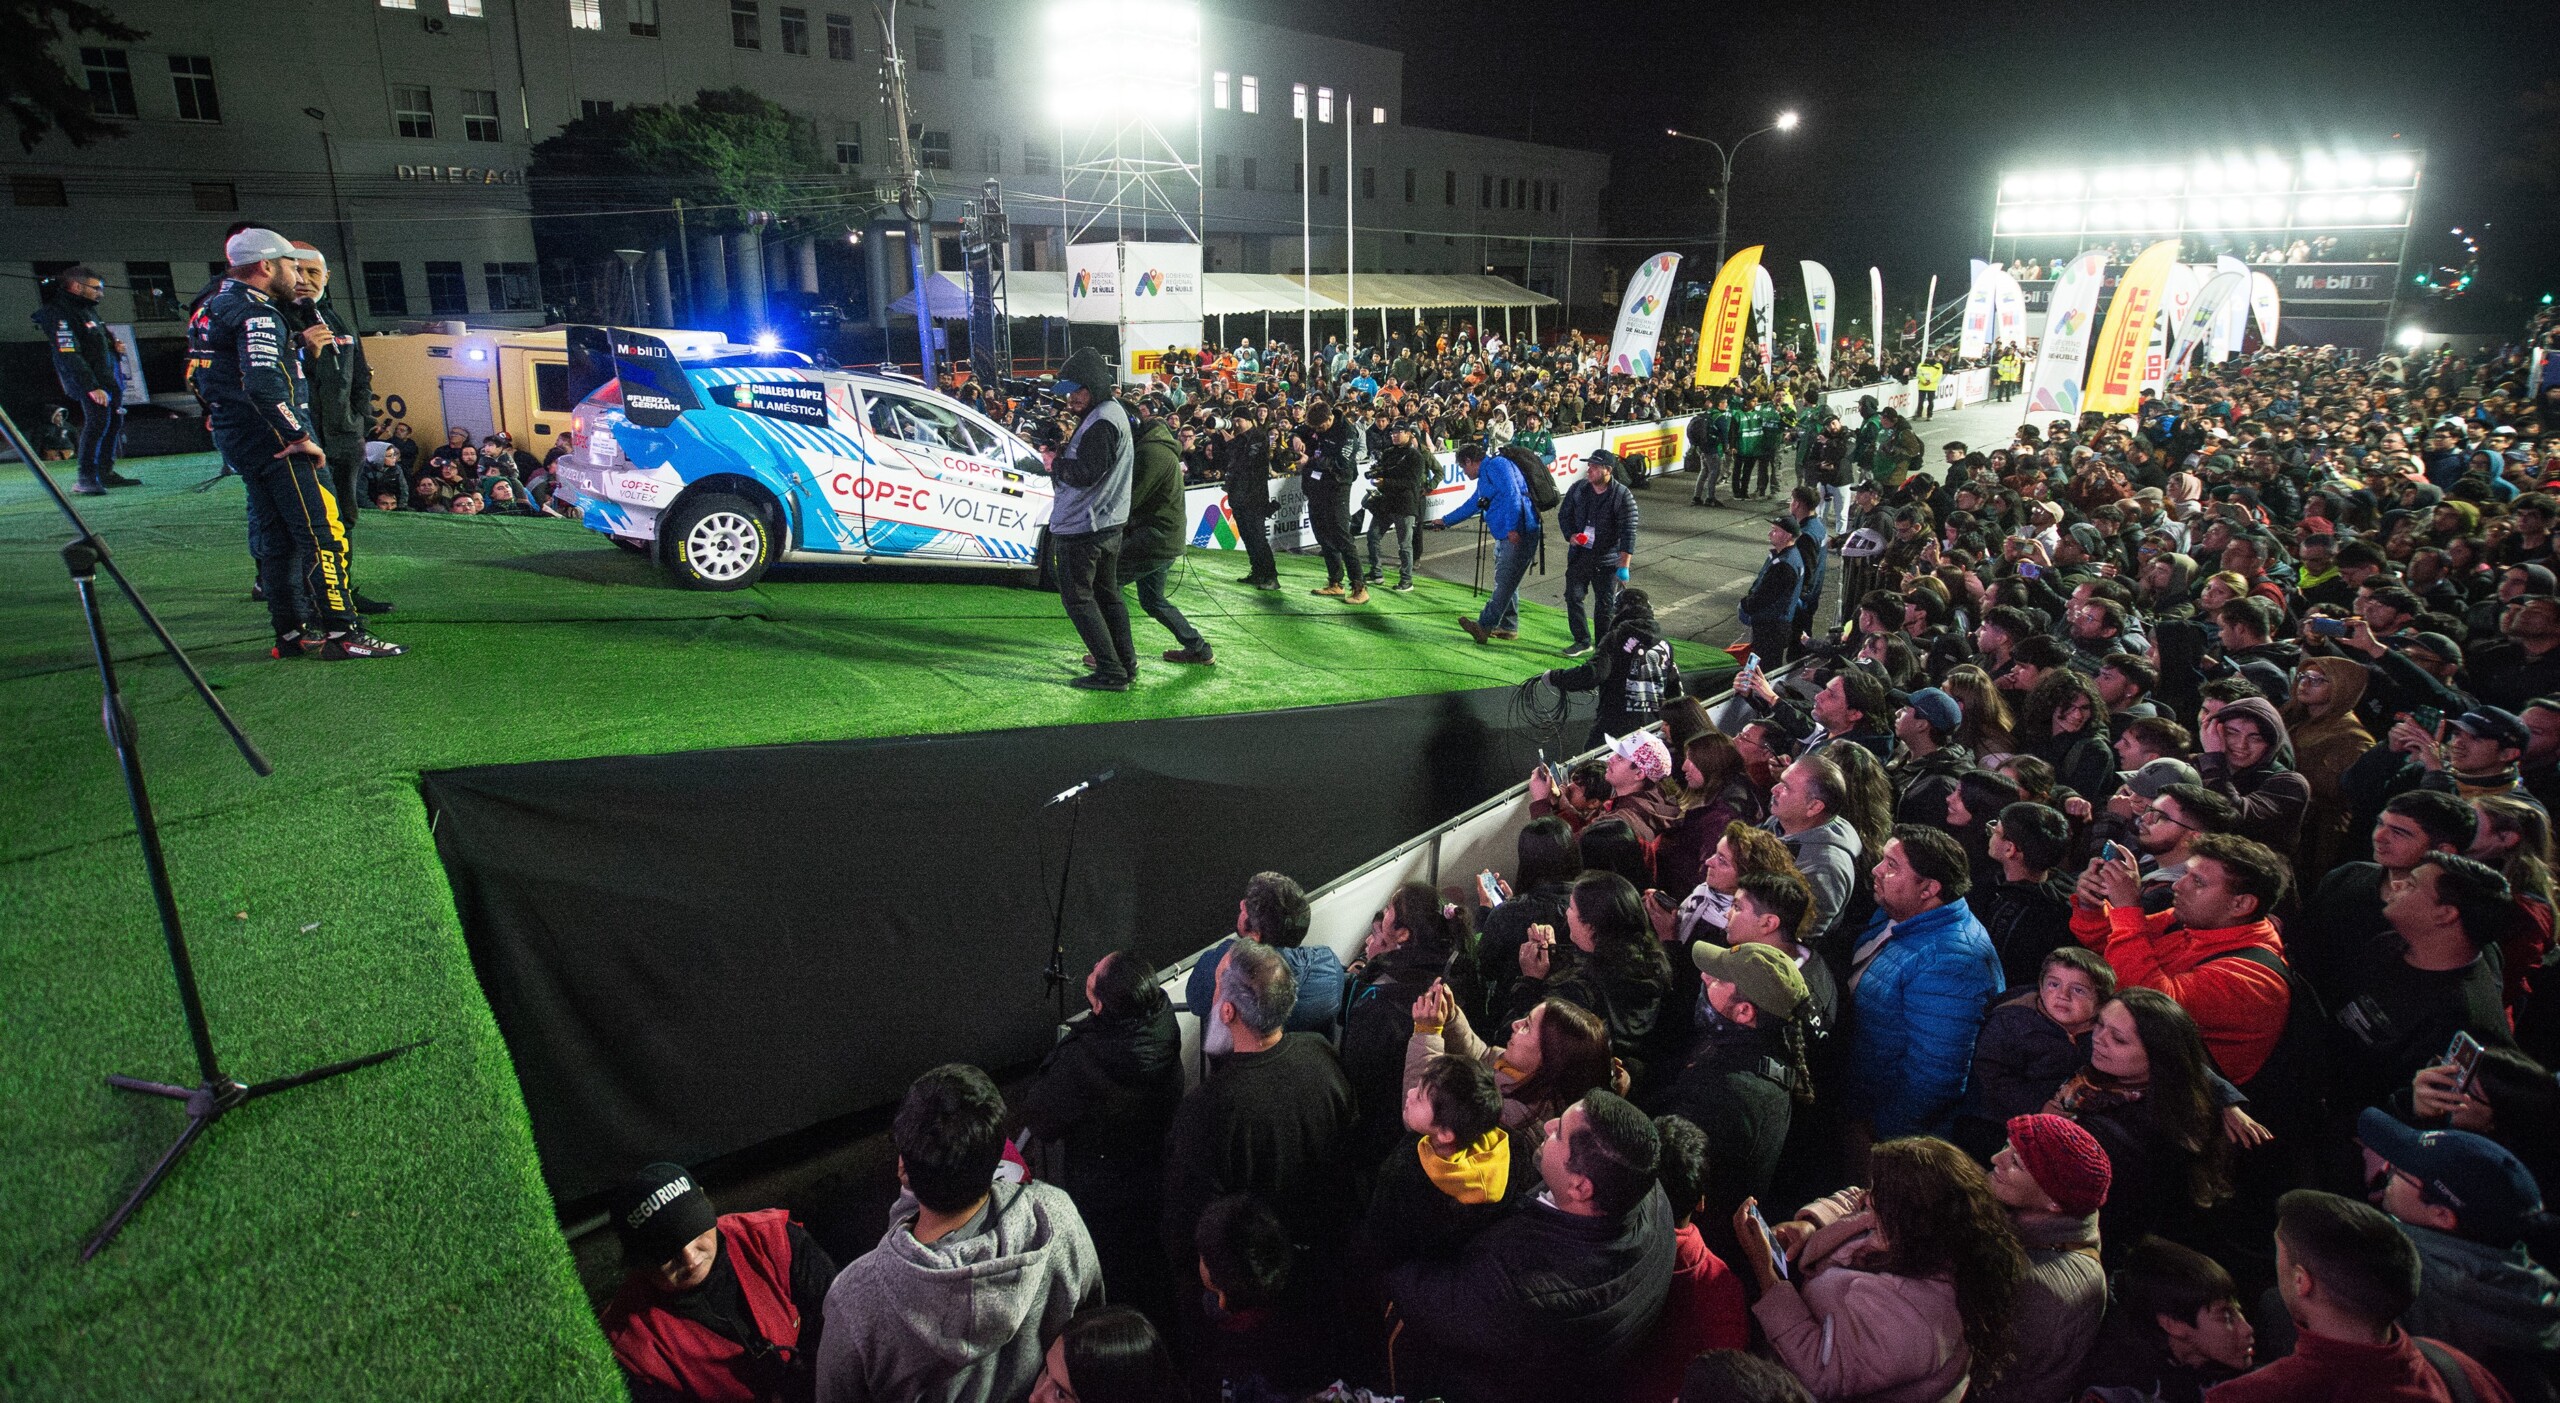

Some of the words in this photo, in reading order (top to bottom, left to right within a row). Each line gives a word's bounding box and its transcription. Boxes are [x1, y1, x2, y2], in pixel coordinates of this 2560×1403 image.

[1099, 285, 1115, 294] ÑUBLE
[1174, 285, 1193, 293] ÑUBLE
[2295, 275, 2352, 289] Mobil
[247, 332, 277, 341] ROTAX
[1710, 285, 1743, 373] PIRELLI
[618, 344, 652, 357] Mobil
[2103, 287, 2151, 396] PIRELLI
[627, 395, 670, 404] #FUERZA
[752, 384, 795, 397] CHALECO
[795, 388, 823, 400] LÓPEZ
[631, 402, 681, 411] GERMAN14
[766, 401, 824, 417] AMÉSTICA
[831, 387, 845, 417] 7
[1888, 393, 1910, 410] COPEC
[280, 403, 301, 429] COPEC
[1620, 434, 1678, 460] PELLI
[943, 456, 1002, 479] COPEC
[1549, 453, 1578, 477] PEC
[621, 479, 659, 494] COPEC
[1007, 474, 1019, 494] 7
[621, 490, 656, 503] VOLTEX
[832, 473, 930, 511] COPEC
[939, 493, 1028, 531] VOLTEX
[1273, 517, 1310, 535] ÑUBLE
[752, 519, 767, 564] SCORPION
[320, 550, 346, 612] can-am
[627, 1176, 691, 1229] SEGURIDAD
